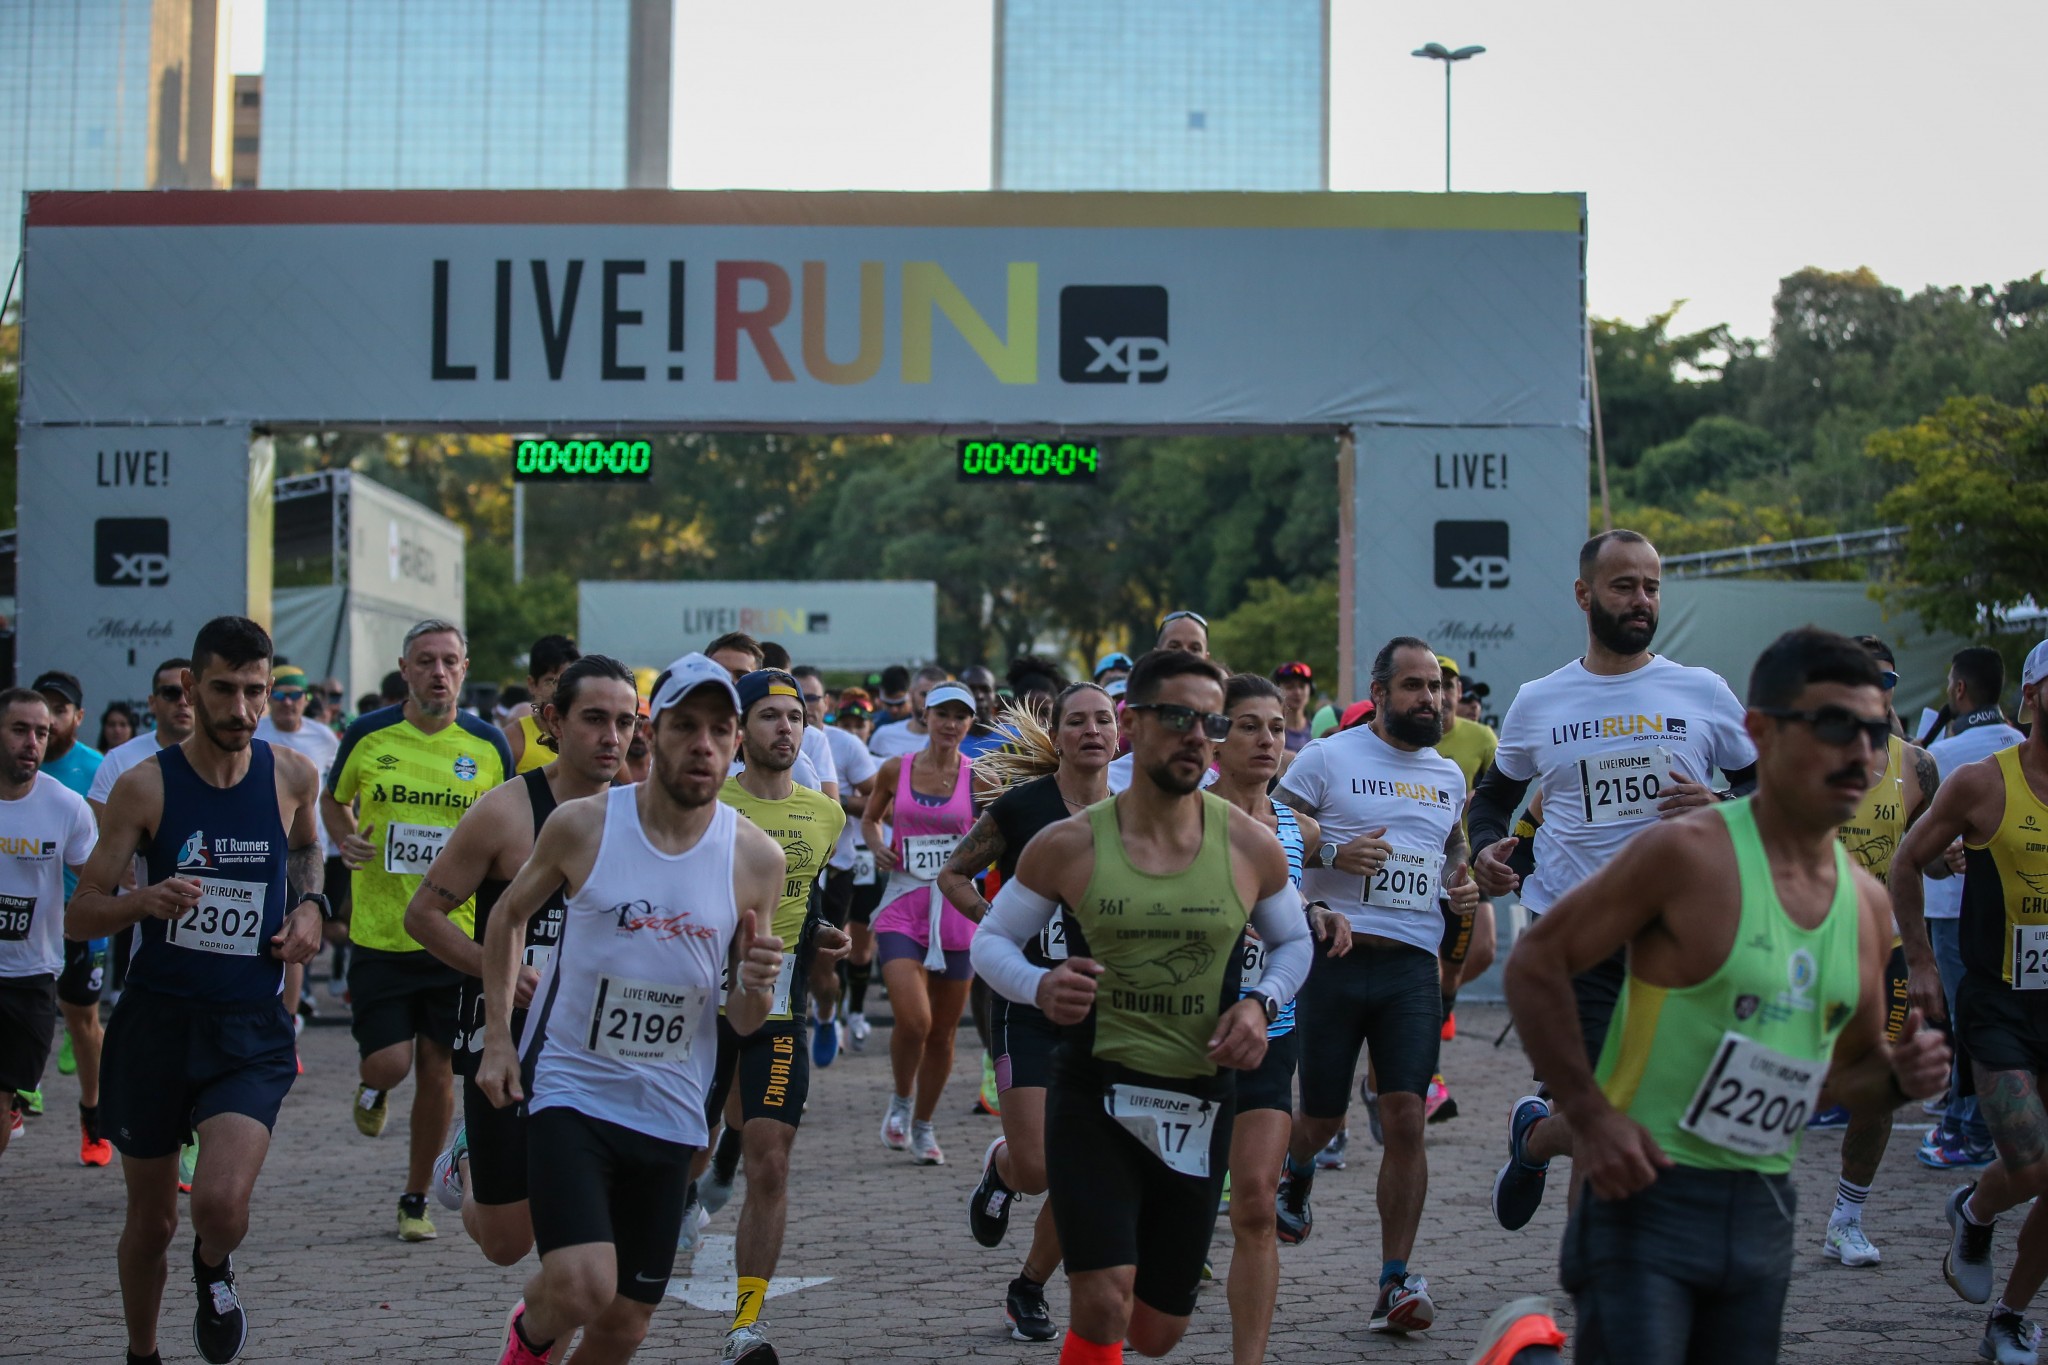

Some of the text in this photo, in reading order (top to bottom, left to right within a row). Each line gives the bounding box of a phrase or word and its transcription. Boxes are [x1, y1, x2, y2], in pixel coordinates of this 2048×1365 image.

[97, 451, 168, 487] LIVE!
[516, 441, 650, 474] 00:00:00
[963, 442, 1097, 475] 00:00:04
[1435, 454, 1507, 488] LIVE!
[87, 617, 173, 640] Michelob
[1427, 621, 1515, 642] Michelob
[1595, 774, 1660, 805] 2150
[1618, 808, 1643, 816] DANIEL
[215, 838, 269, 852] RT Runners
[789, 830, 802, 838] DOS
[200, 885, 243, 899] IVE!RUN
[1375, 869, 1428, 896] 2016
[1392, 898, 1411, 906] DANTE
[181, 904, 259, 938] 2302
[199, 940, 235, 950] RODRIGO
[1111, 989, 1205, 1015] CAVALOS
[606, 1008, 685, 1044] 2196
[763, 1036, 793, 1107] CAVALOS
[1710, 1078, 1807, 1136] 2200
